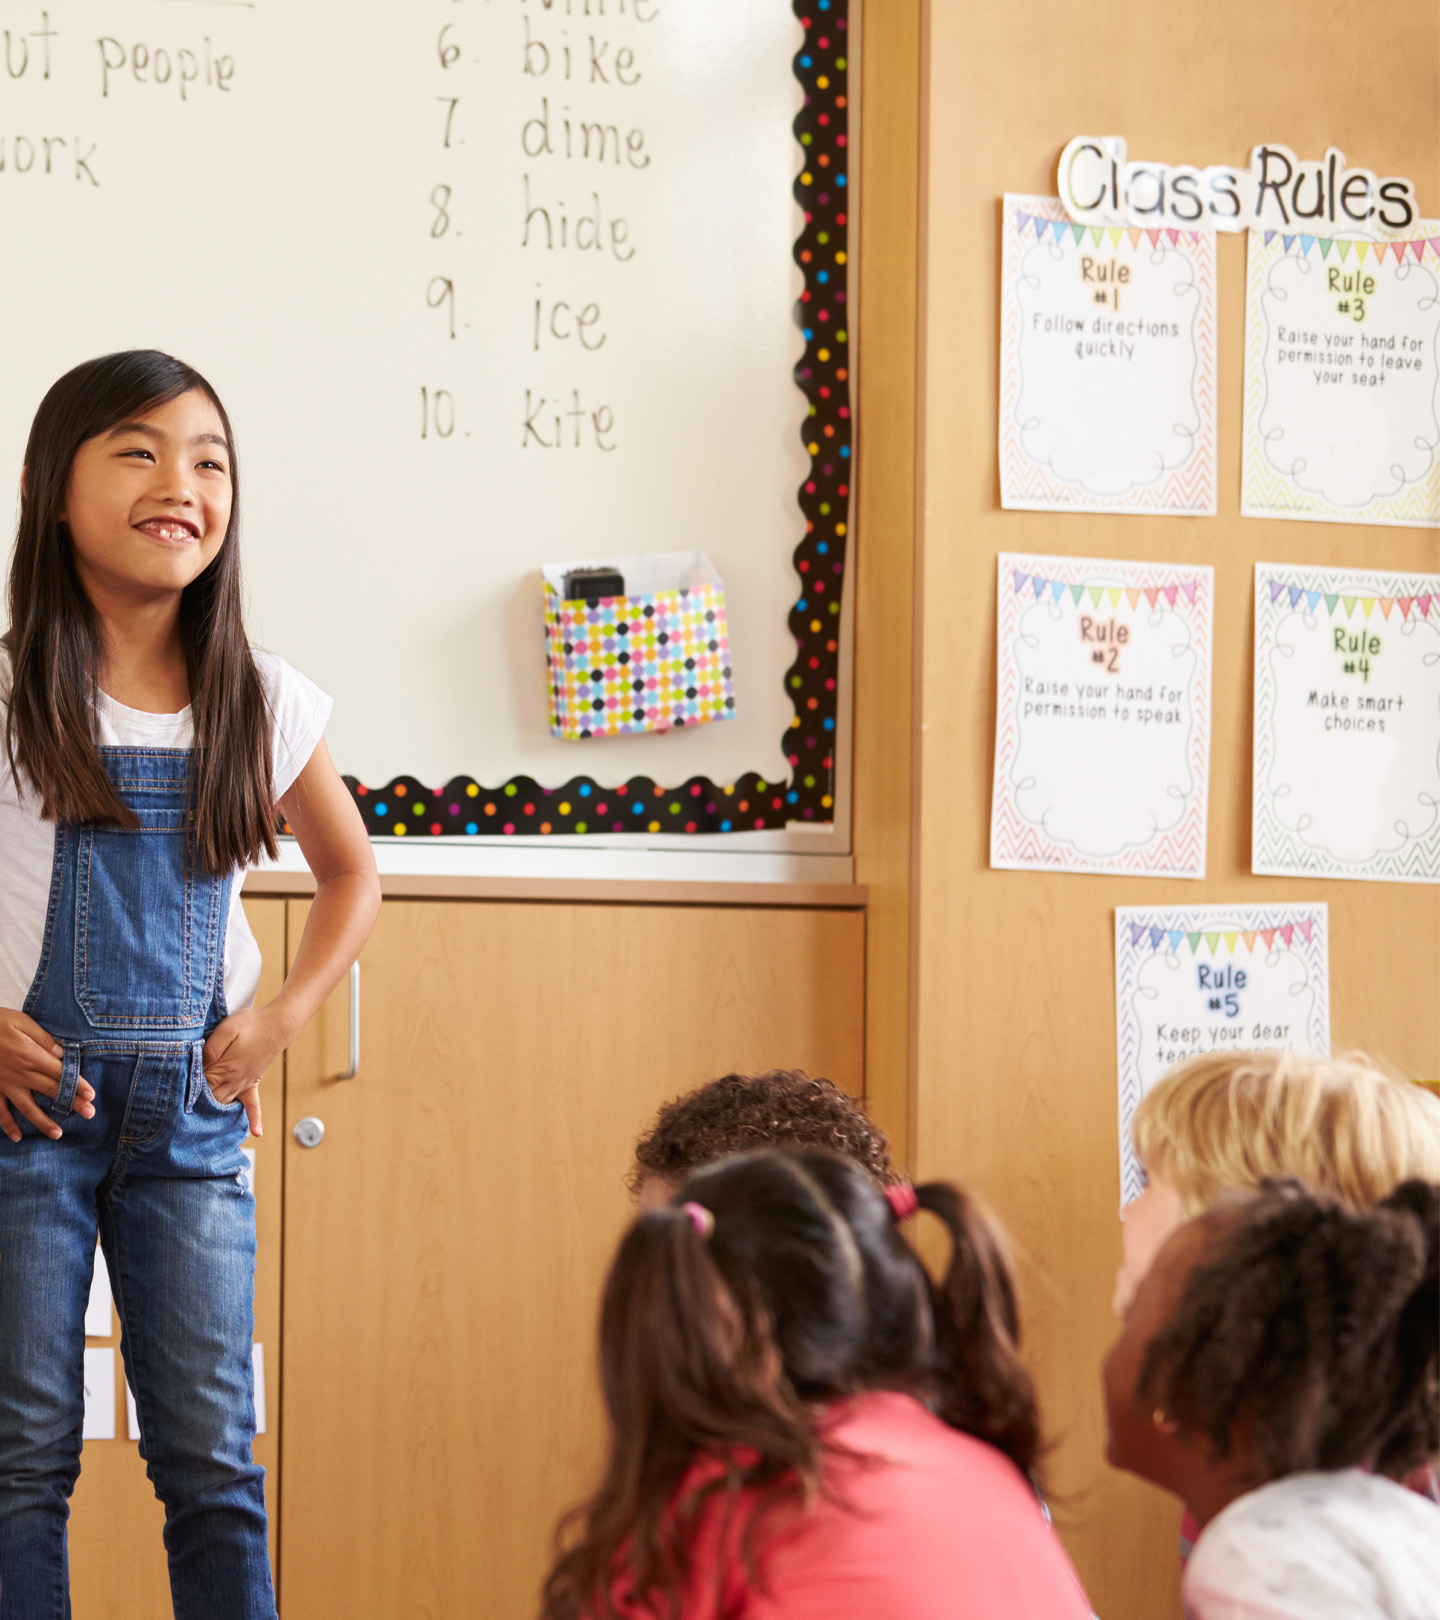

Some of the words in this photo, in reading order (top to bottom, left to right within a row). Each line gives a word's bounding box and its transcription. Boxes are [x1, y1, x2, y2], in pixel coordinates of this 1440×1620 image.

[522, 11, 644, 86] bike
[95, 36, 235, 102] people
[521, 95, 652, 169] dime
[1067, 141, 1242, 222] Class
[1255, 146, 1414, 229] Rules
[429, 183, 463, 239] 8.
[520, 172, 637, 262] hide
[1081, 257, 1130, 284] Rule
[1328, 267, 1375, 295] Rule
[426, 275, 469, 340] 9.
[533, 282, 608, 352] ice
[1337, 297, 1365, 322] #3
[1033, 313, 1085, 333] Follow
[1091, 316, 1180, 338] directions
[1074, 338, 1135, 360] quickly
[1277, 325, 1319, 346] Raise
[1324, 334, 1355, 349] your
[1361, 333, 1396, 351] hand
[1401, 335, 1424, 353] for
[1278, 346, 1354, 367] permission
[1359, 351, 1375, 369] to
[1380, 352, 1423, 372] leave
[1313, 370, 1345, 385] your
[1351, 371, 1386, 387] seat
[420, 385, 471, 440] 10.
[1080, 616, 1129, 644] Rule
[1334, 627, 1381, 656] Rule
[1092, 647, 1118, 673] #2
[1343, 658, 1370, 683] #4
[1024, 676, 1069, 697] Raise
[1075, 684, 1110, 700] your
[1116, 683, 1153, 702] hand
[1159, 685, 1183, 704] for
[1307, 690, 1350, 710] Make
[1357, 695, 1404, 713] smart
[1023, 701, 1107, 719] permission
[1113, 703, 1130, 721] to
[1137, 707, 1182, 725] speak
[1324, 710, 1386, 734] choices
[1198, 964, 1247, 990] Rule
[1208, 993, 1240, 1018] #5
[1156, 1023, 1202, 1046] Keep
[1207, 1026, 1245, 1047] your
[1252, 1022, 1291, 1040] dear
